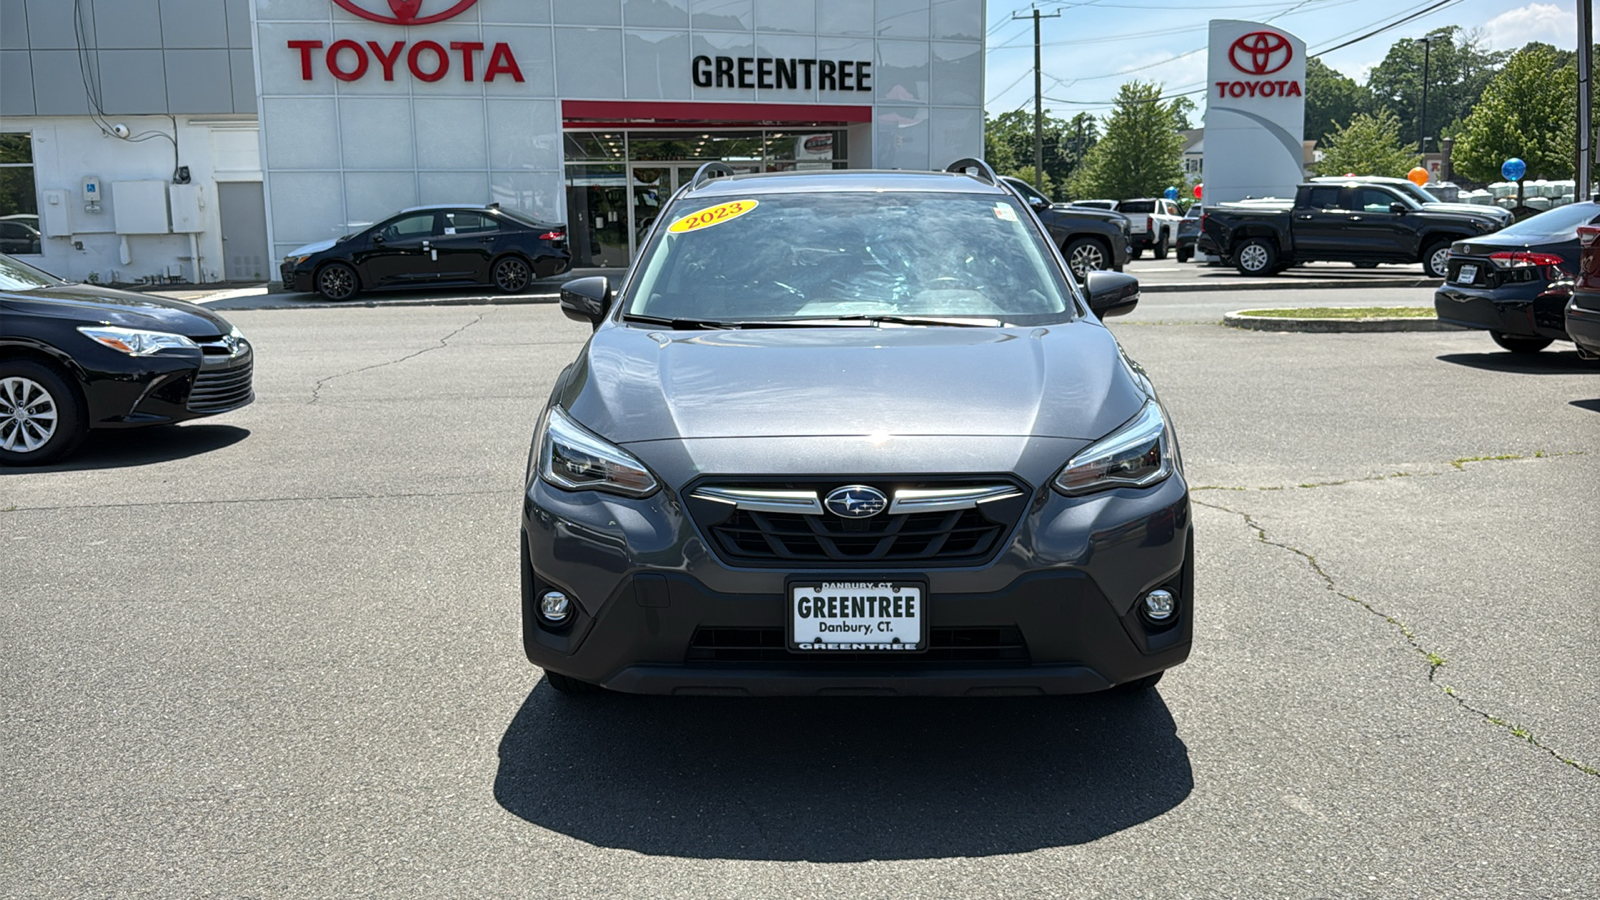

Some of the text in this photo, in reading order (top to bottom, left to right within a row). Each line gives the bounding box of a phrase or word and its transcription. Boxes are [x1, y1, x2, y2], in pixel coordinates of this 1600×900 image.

[287, 39, 525, 83] TOYOTA
[692, 55, 872, 92] GREENTREE
[1215, 80, 1302, 98] TOYOTA
[686, 203, 743, 229] 2023
[798, 596, 915, 619] GREENTREE
[819, 621, 893, 635] Danbury, CT.
